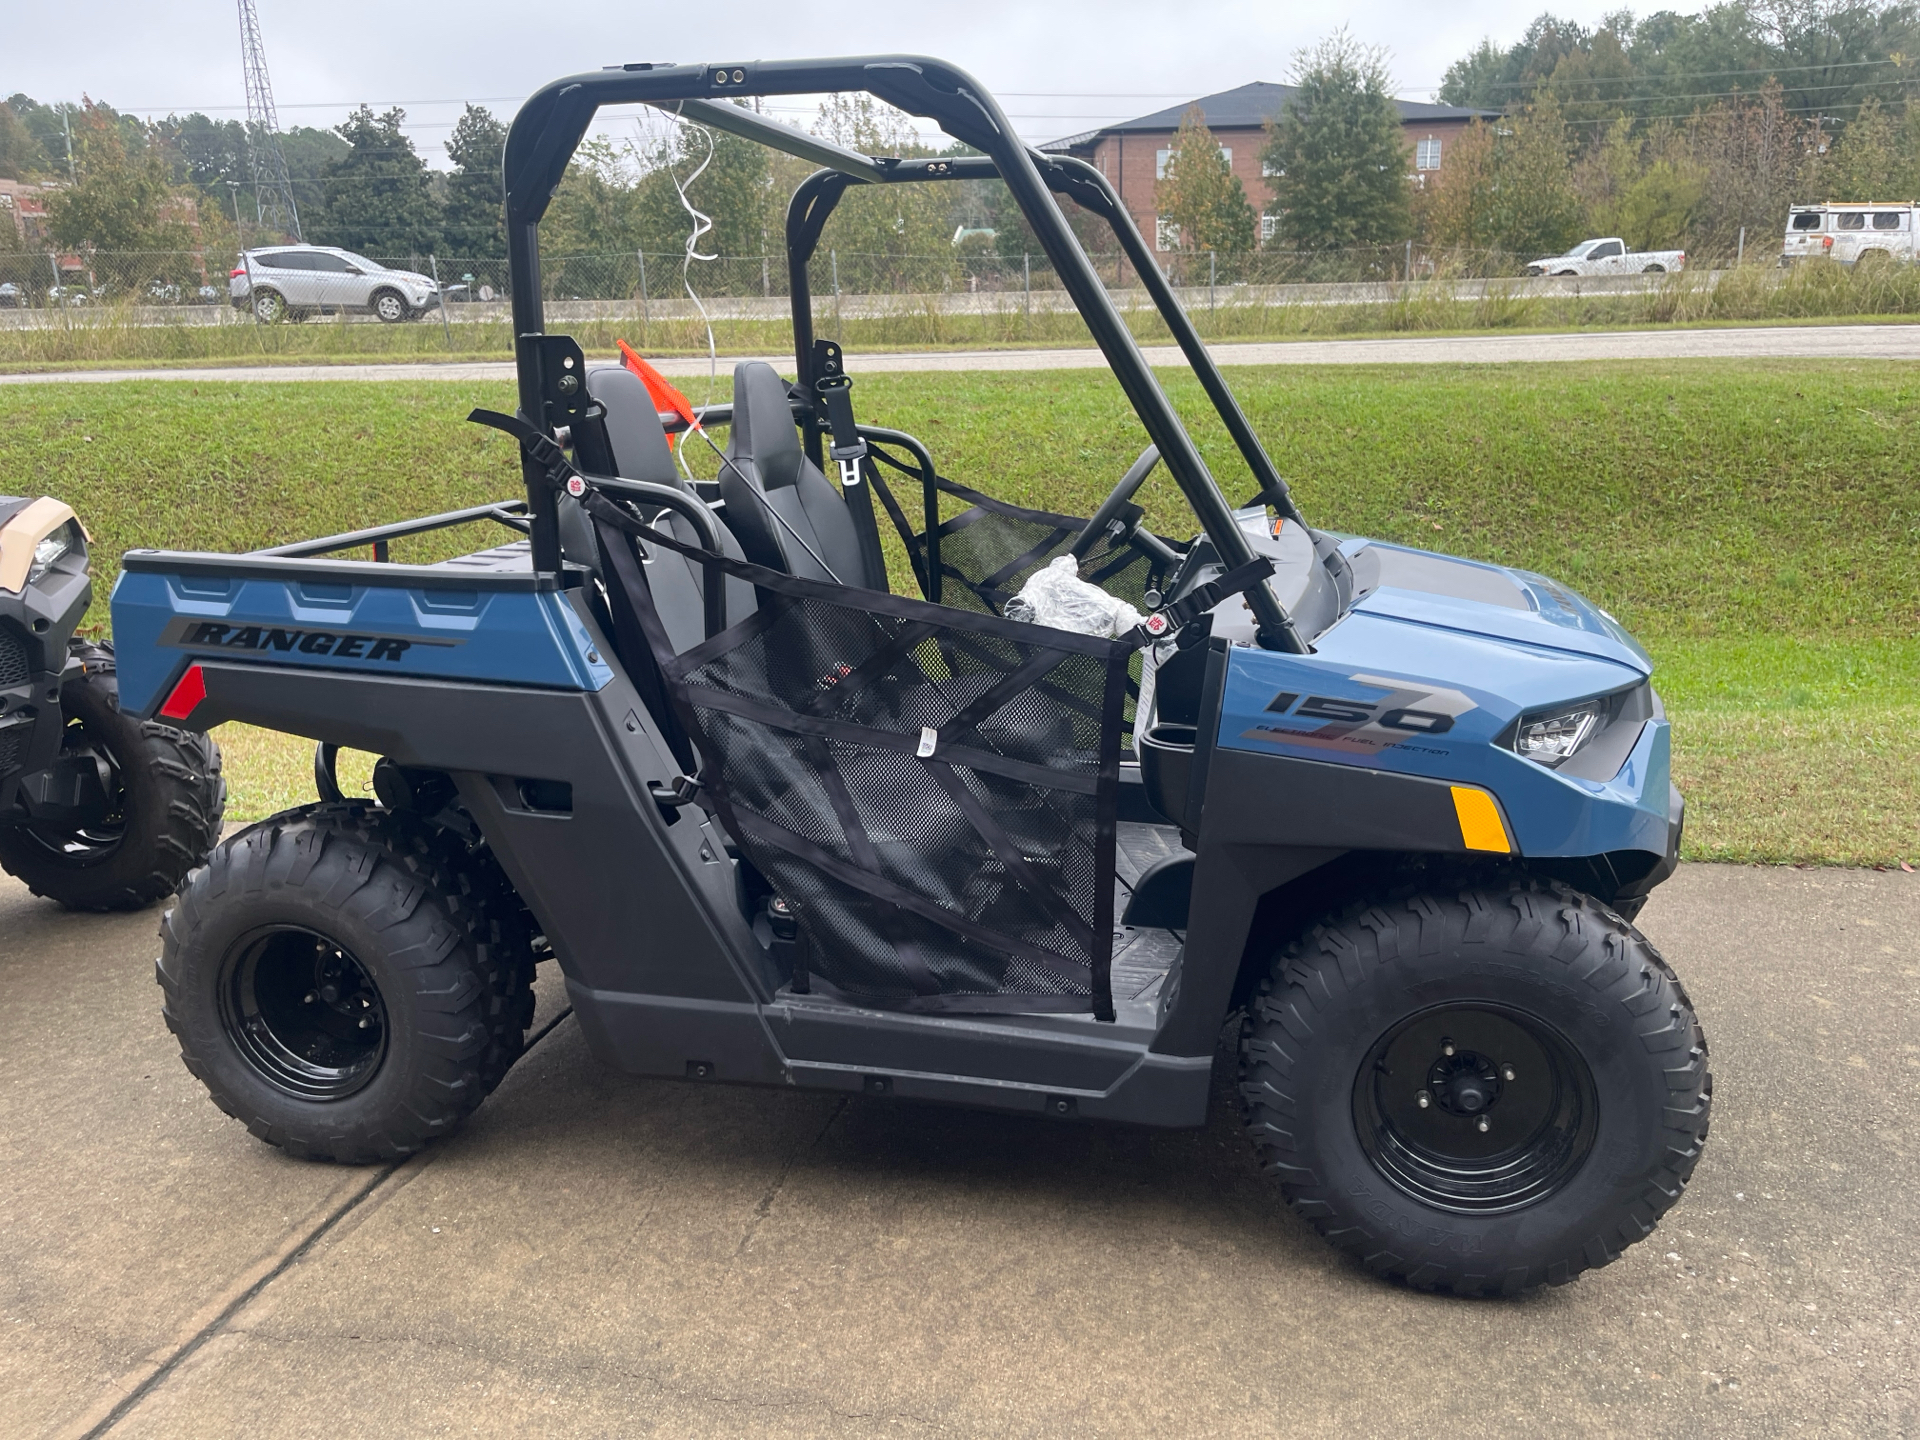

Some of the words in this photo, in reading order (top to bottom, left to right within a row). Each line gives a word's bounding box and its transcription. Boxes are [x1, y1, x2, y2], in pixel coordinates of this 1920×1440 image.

[190, 622, 411, 661] RANGER
[1263, 691, 1456, 734] 150
[1256, 725, 1335, 741] ELECTRONIC
[1342, 736, 1376, 746] FUEL
[1382, 742, 1450, 756] INJECTION
